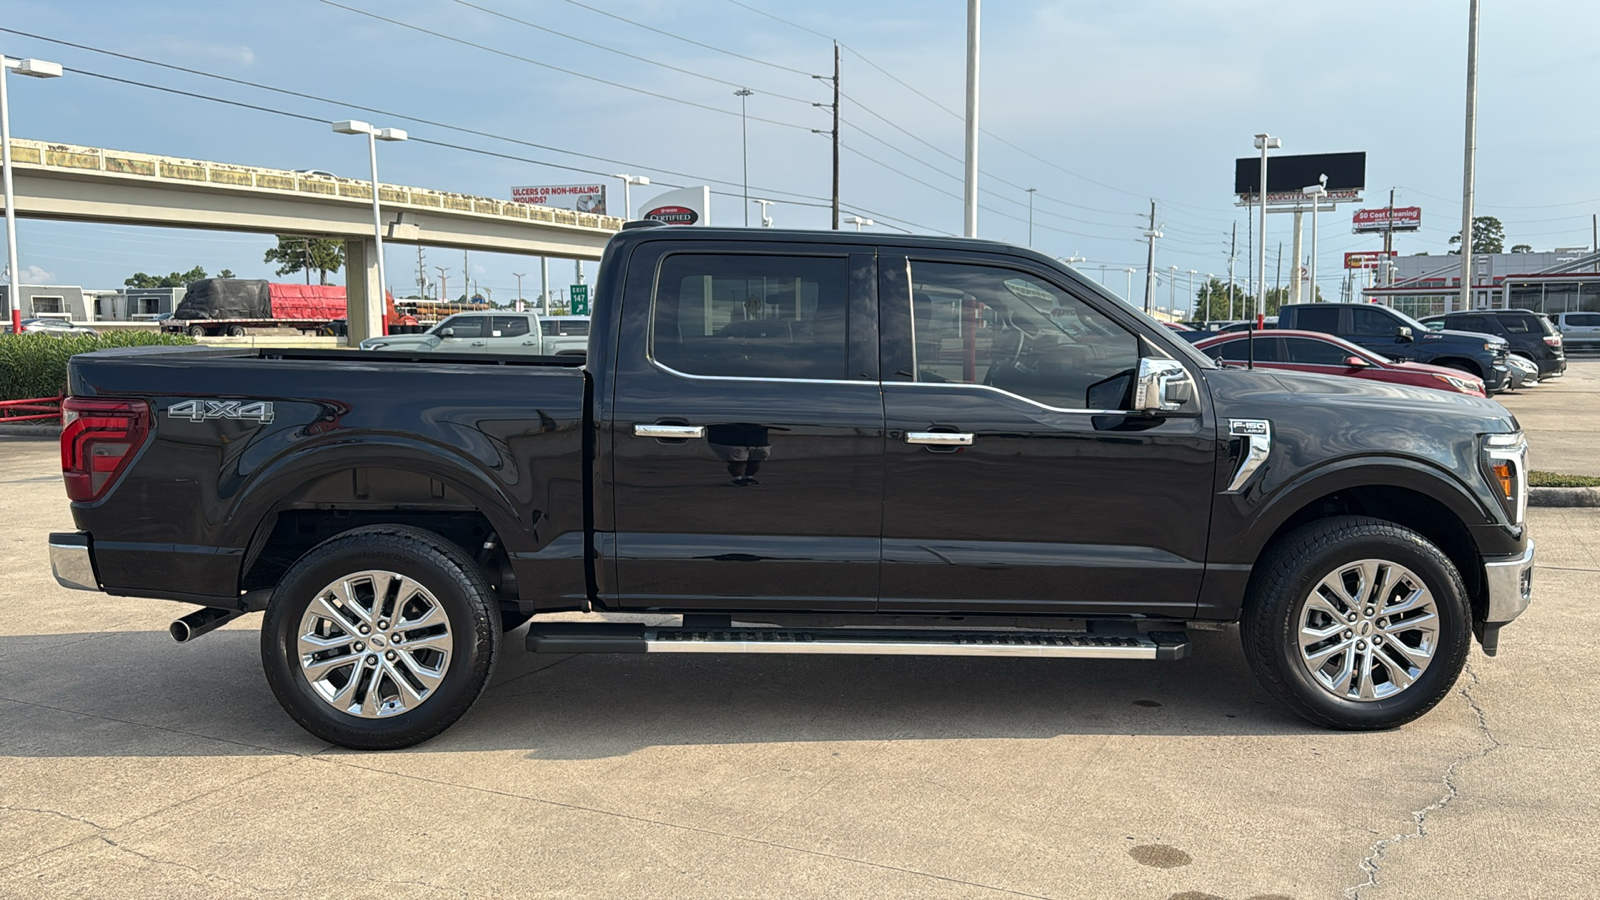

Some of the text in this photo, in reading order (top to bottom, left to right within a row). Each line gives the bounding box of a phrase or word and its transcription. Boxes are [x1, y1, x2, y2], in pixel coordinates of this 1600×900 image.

[512, 186, 600, 196] ULCERS OR NON-HEALING
[513, 196, 547, 204] WOUNDS?
[650, 214, 691, 222] CERTIFIED
[573, 294, 585, 302] 147
[1233, 422, 1266, 430] F-150
